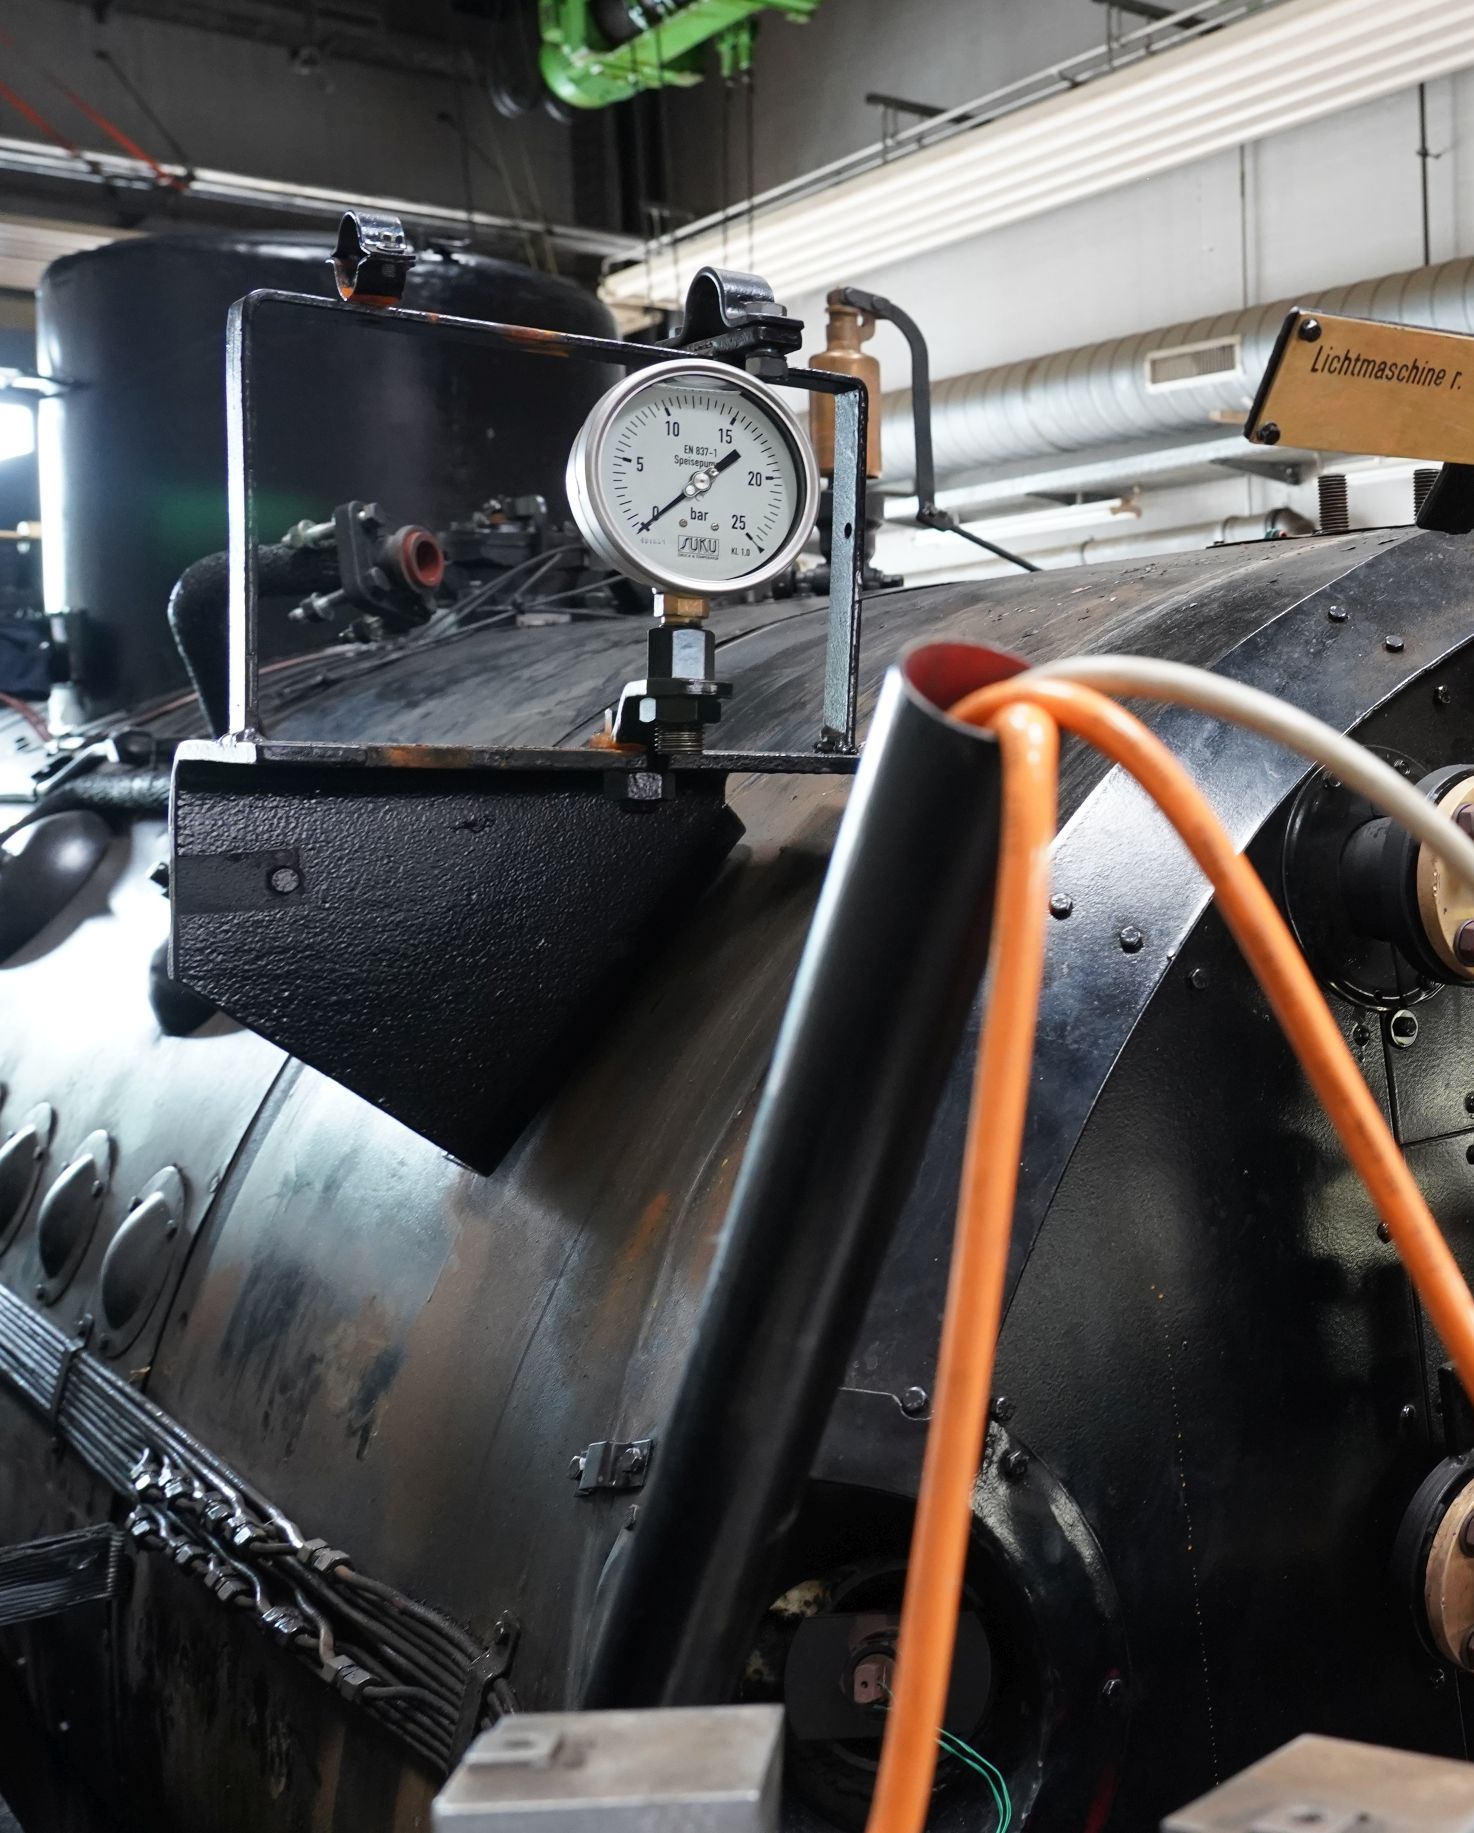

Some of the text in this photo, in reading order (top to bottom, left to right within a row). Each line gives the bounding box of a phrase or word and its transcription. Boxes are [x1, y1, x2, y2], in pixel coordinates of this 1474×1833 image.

[1310, 345, 1463, 390] Lichtmaschine r.
[665, 420, 680, 437] 10
[718, 427, 733, 445] 15
[684, 444, 717, 458] EN 837-1
[636, 456, 644, 472] 5
[748, 471, 762, 487] 20
[690, 506, 709, 522] bar
[731, 514, 746, 531] 25
[679, 537, 717, 554] SUKU
